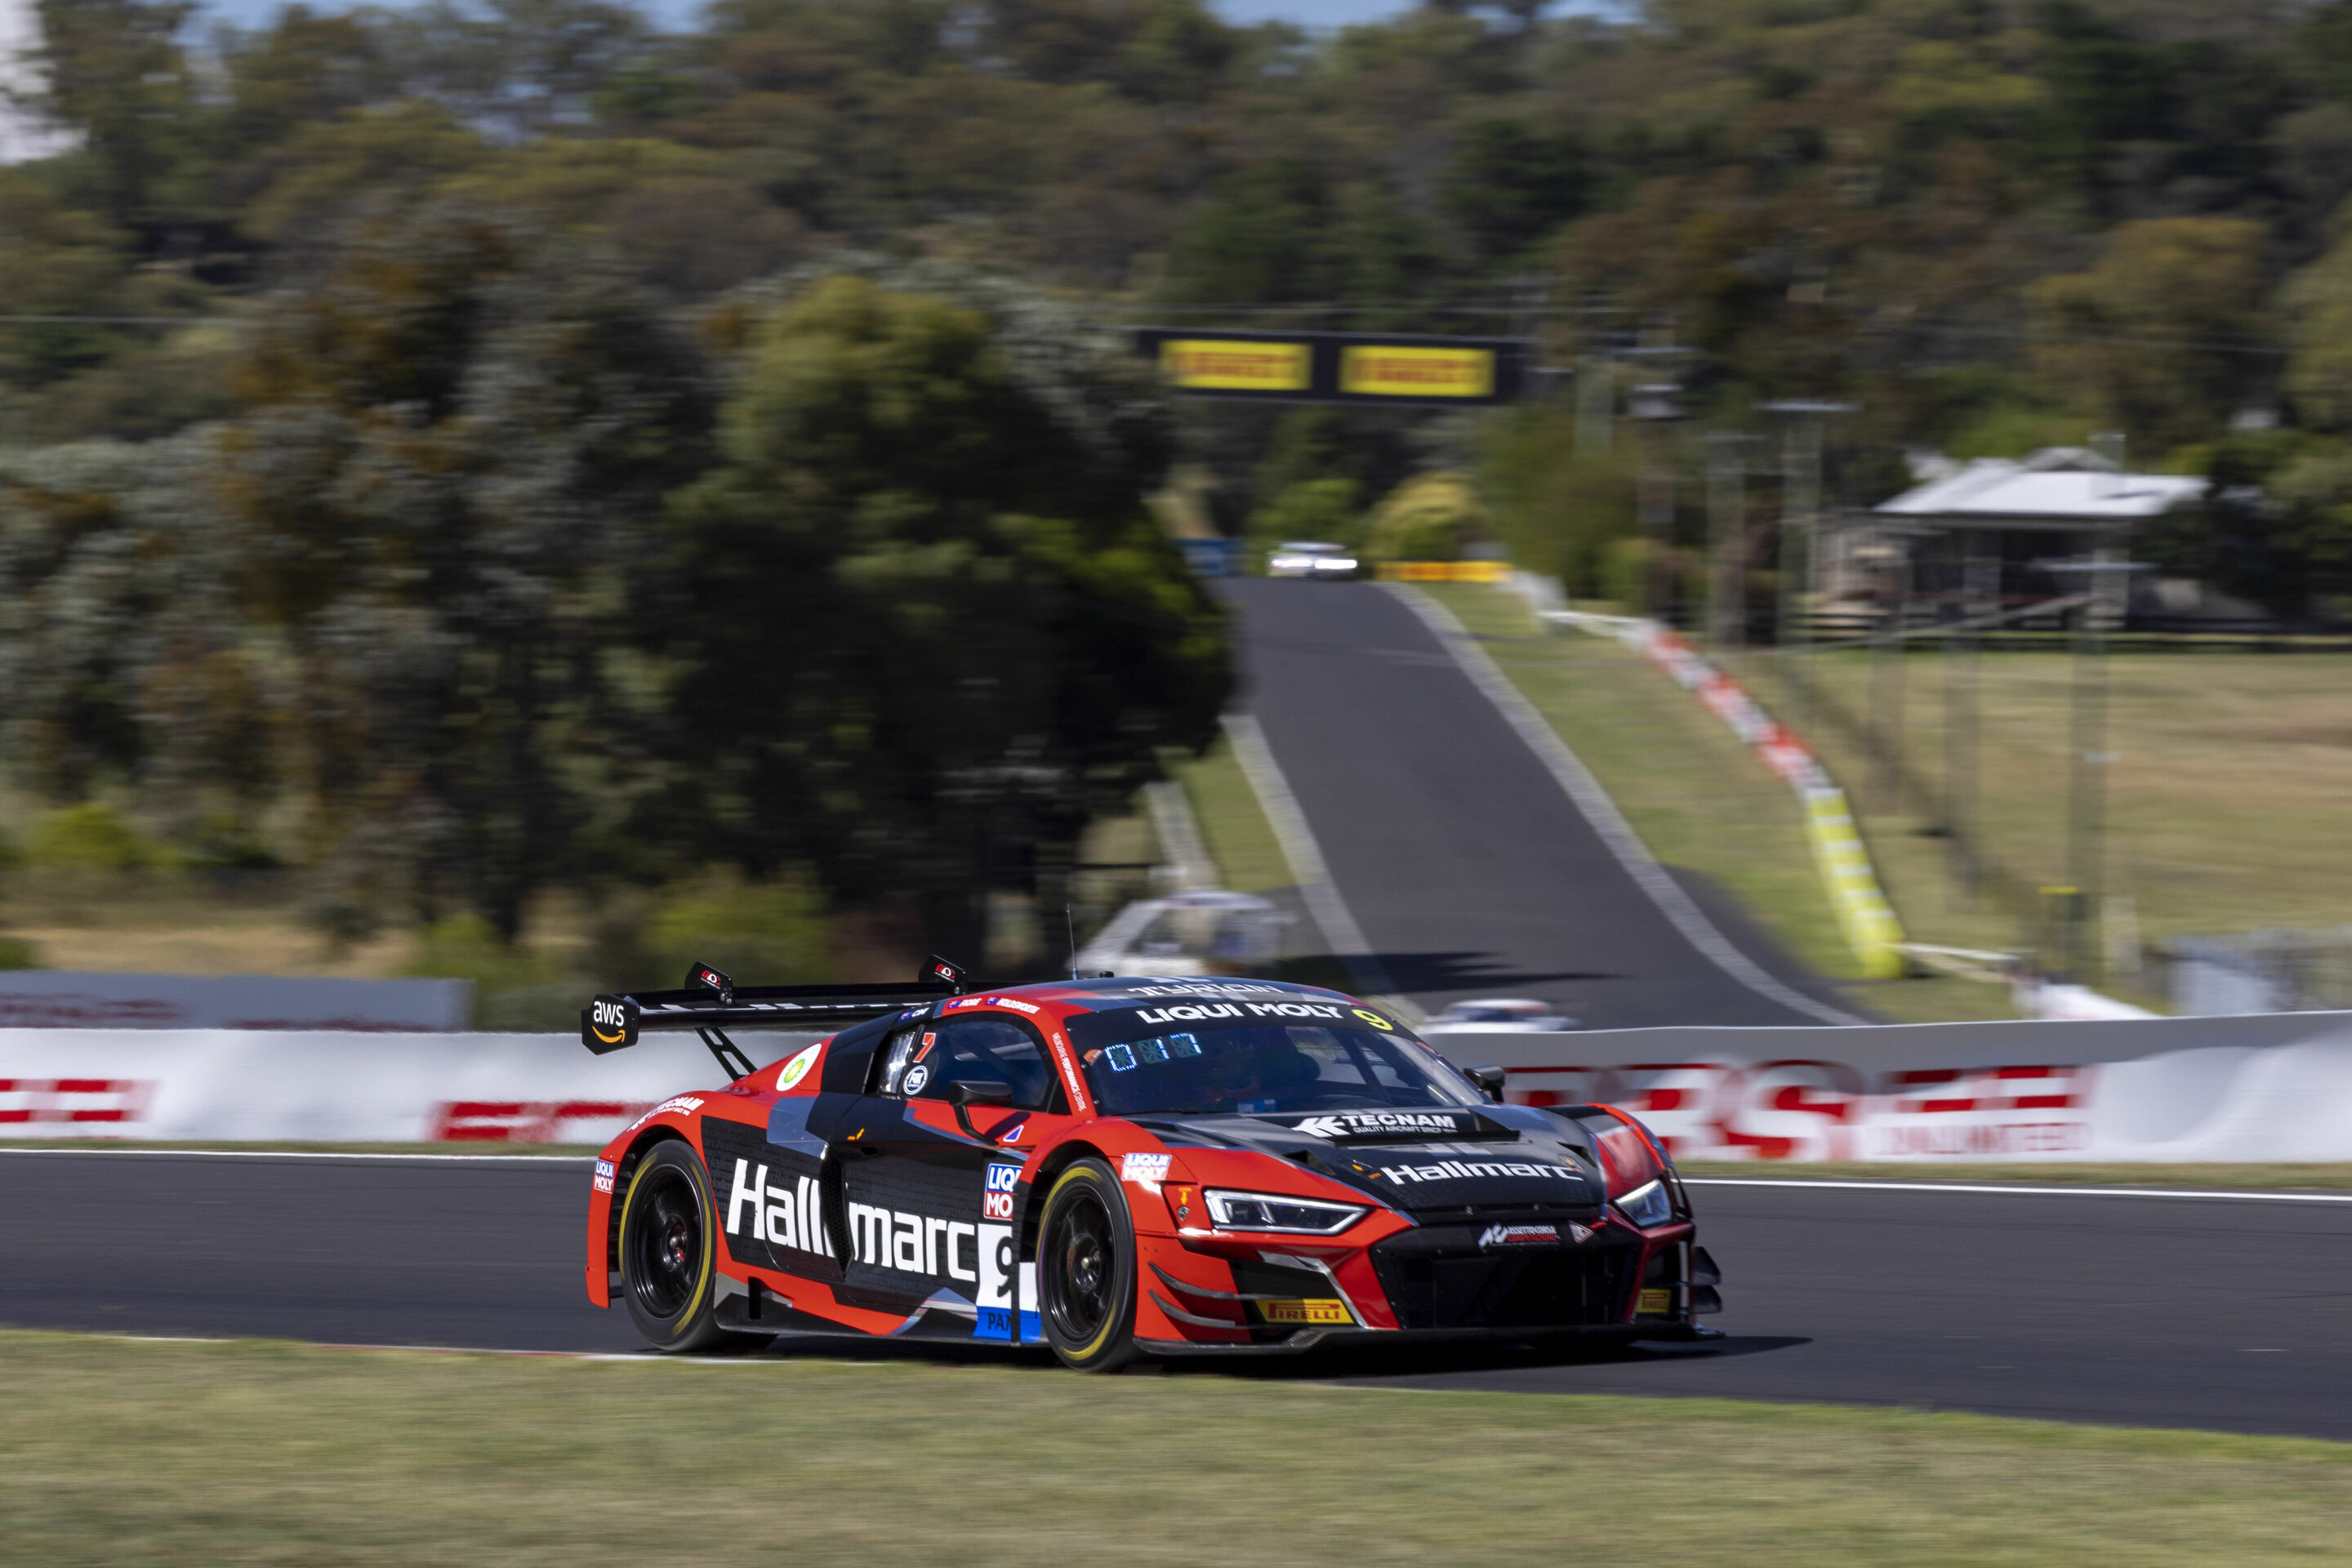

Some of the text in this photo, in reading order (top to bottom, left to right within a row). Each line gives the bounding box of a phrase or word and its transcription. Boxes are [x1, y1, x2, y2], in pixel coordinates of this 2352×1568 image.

[594, 1000, 625, 1027] aws
[1136, 1003, 1344, 1023] LIQUI MOLY
[1352, 1009, 1394, 1031] 9
[913, 1032, 937, 1062] 7
[1104, 1032, 1202, 1071] 017
[1341, 1114, 1457, 1129] TECNAM
[1352, 1126, 1385, 1134] QUALITY
[596, 1160, 613, 1178] LIQUI
[1126, 1154, 1169, 1166] LIQUI
[1380, 1160, 1585, 1185] Hallmarc
[595, 1174, 613, 1192] MOLY
[996, 1236, 1013, 1298] 9
[1267, 1303, 1341, 1320] PIRELLI
